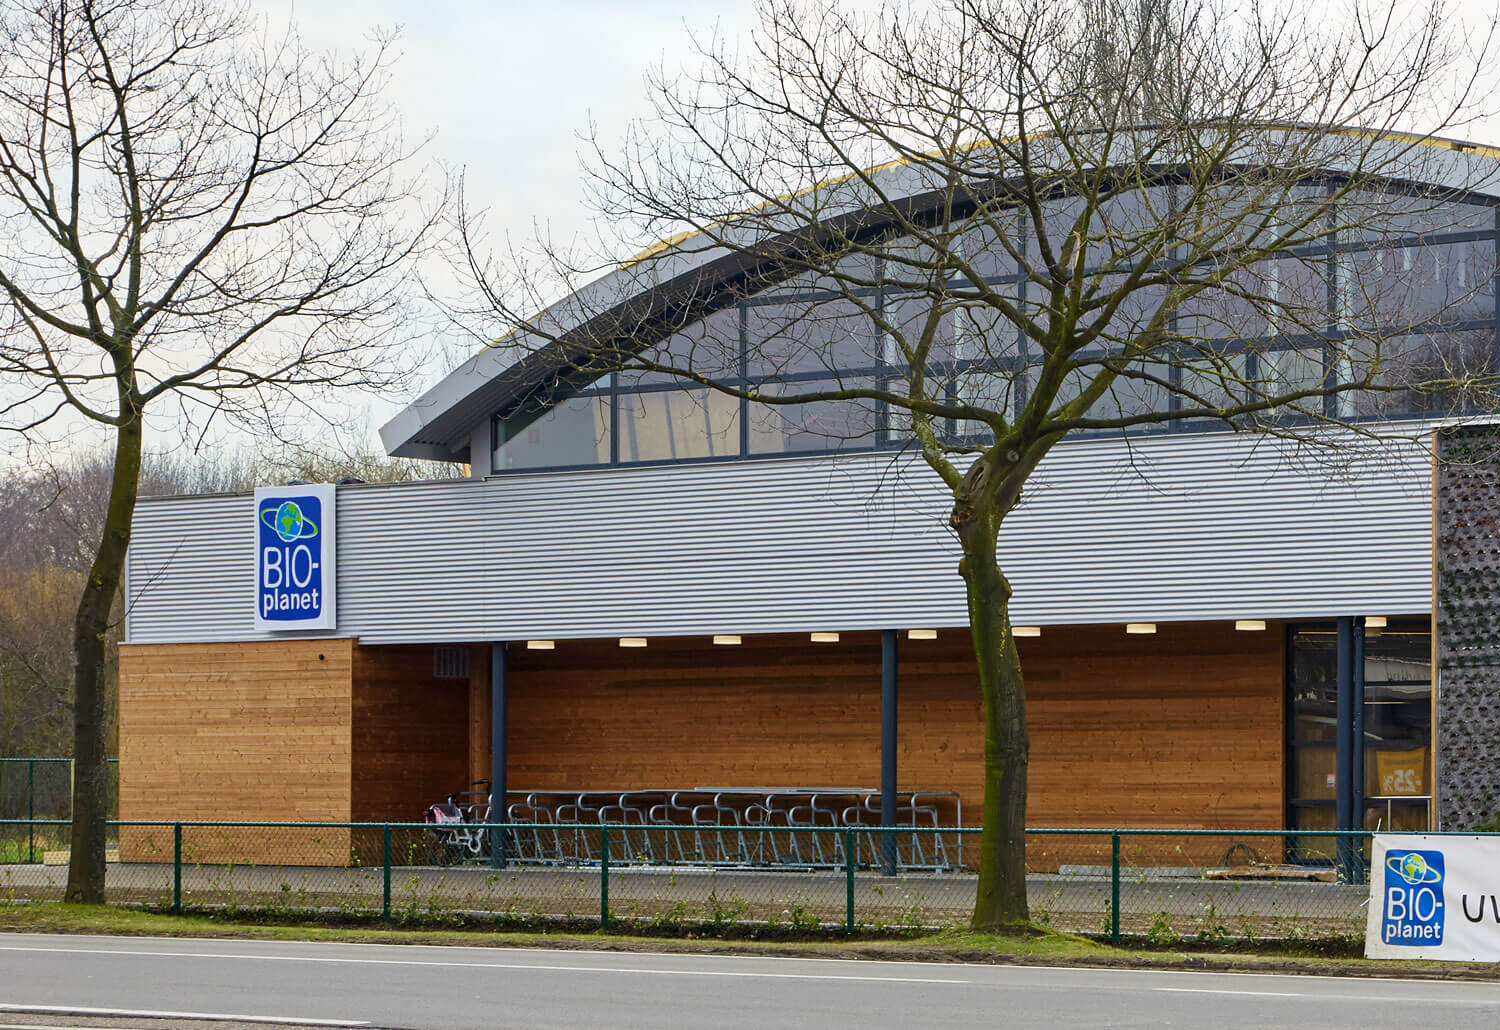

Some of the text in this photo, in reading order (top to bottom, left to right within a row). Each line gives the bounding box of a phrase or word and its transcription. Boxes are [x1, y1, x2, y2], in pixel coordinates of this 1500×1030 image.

[263, 545, 319, 588] BIO-
[263, 588, 319, 618] planet
[1387, 887, 1443, 921] BIO-
[1386, 920, 1441, 943] planet
